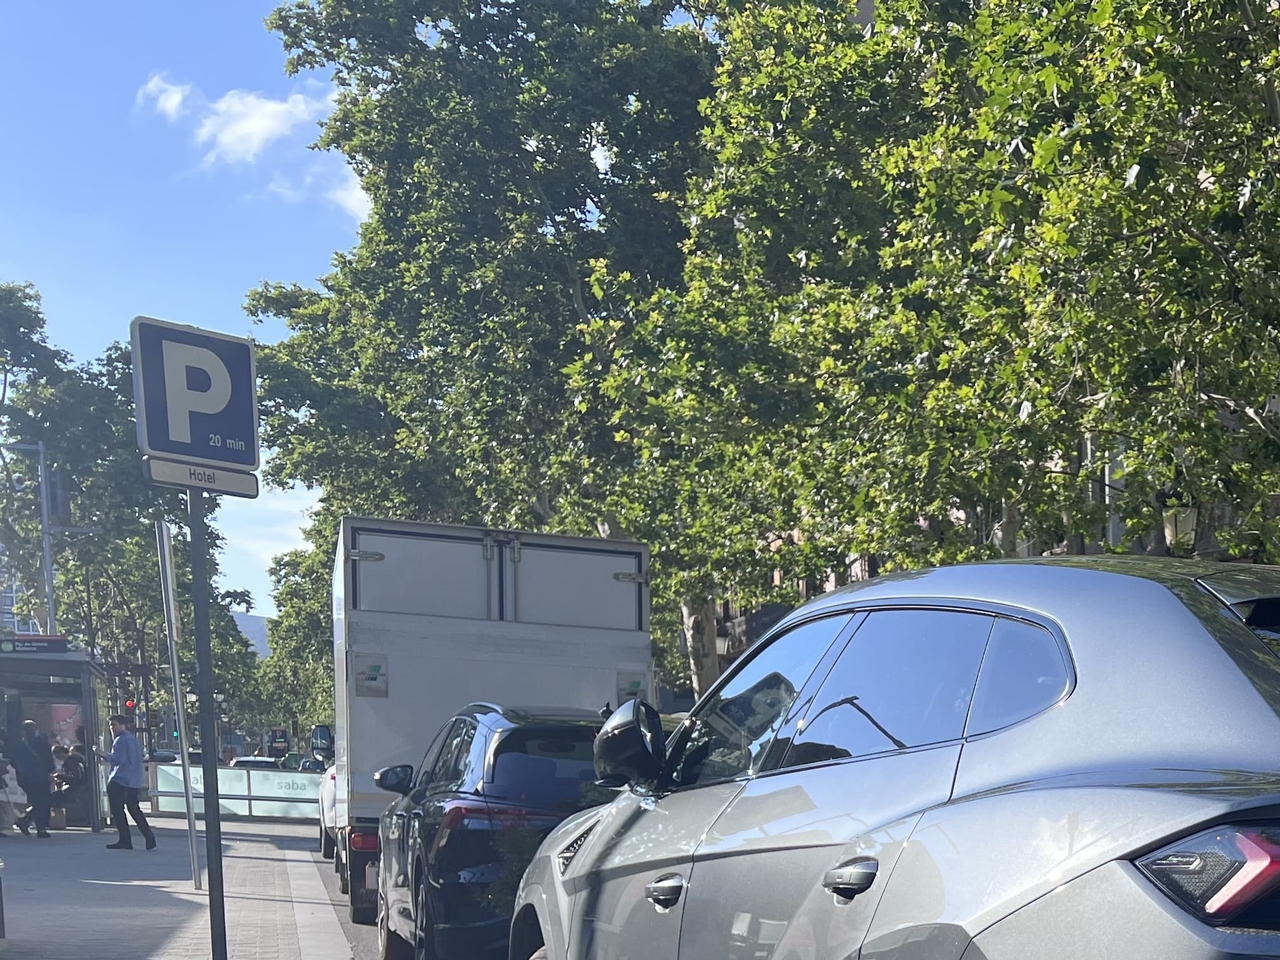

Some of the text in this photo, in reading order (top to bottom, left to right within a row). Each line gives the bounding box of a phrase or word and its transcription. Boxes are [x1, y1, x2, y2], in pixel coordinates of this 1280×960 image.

[162, 339, 232, 443] P
[209, 434, 245, 450] 20 min
[189, 468, 216, 484] Hotel
[276, 779, 307, 791] saba
